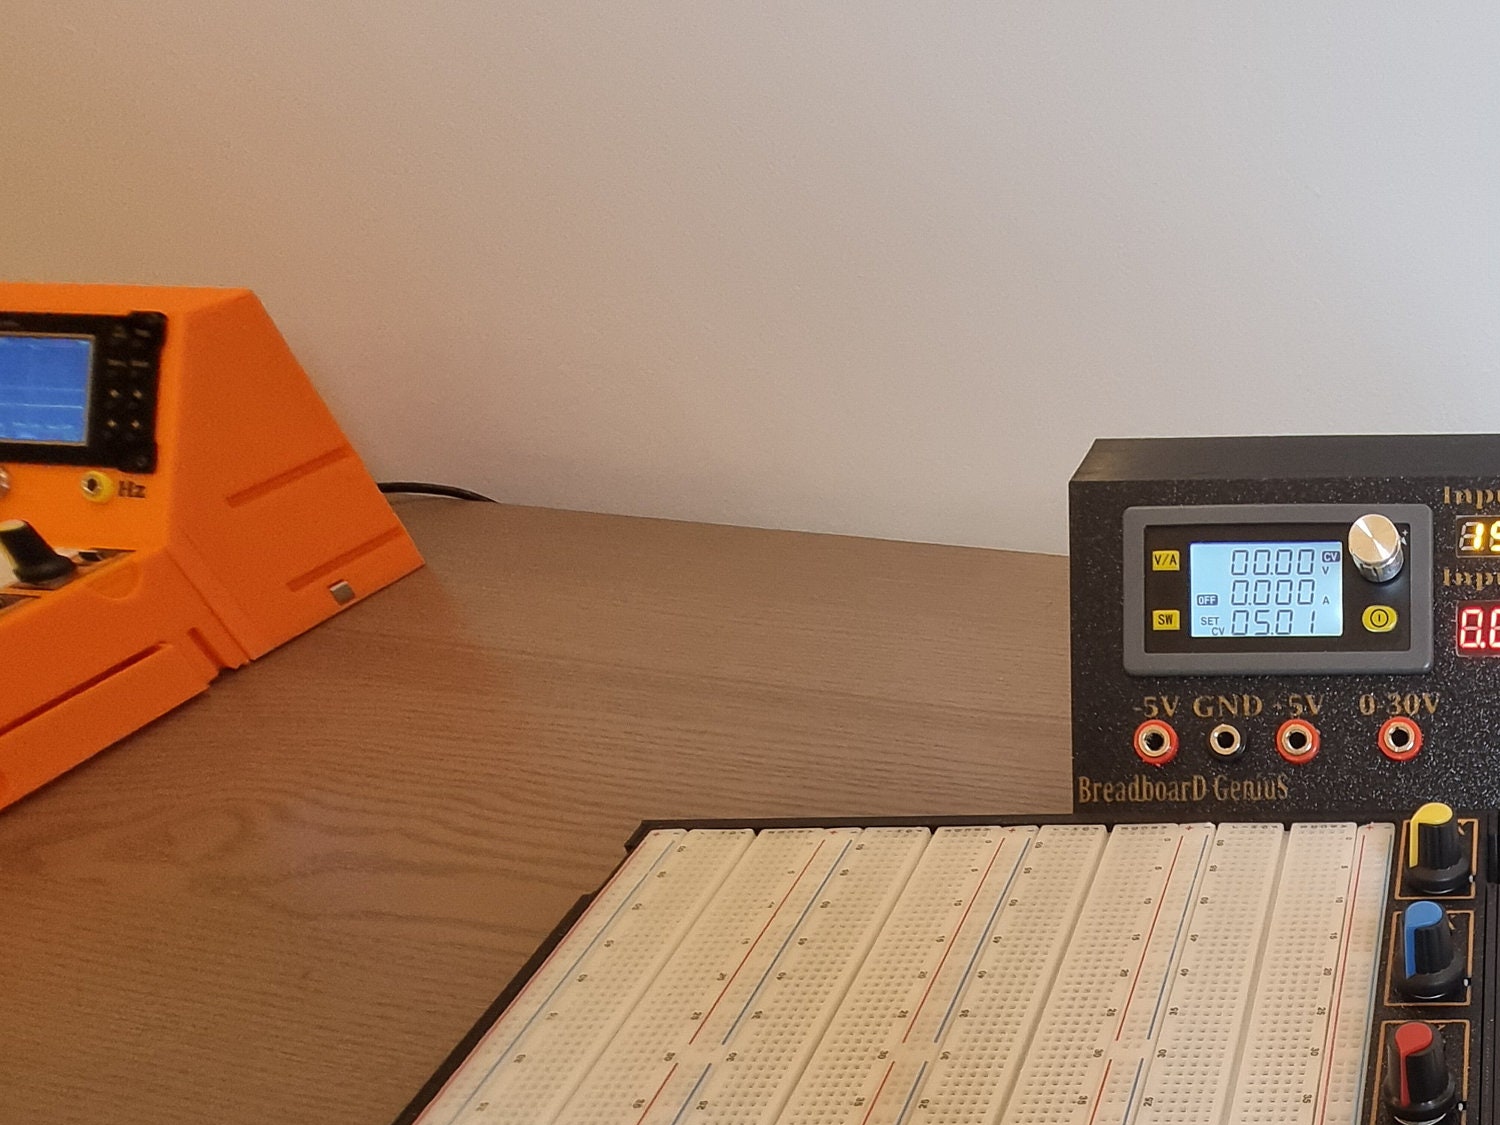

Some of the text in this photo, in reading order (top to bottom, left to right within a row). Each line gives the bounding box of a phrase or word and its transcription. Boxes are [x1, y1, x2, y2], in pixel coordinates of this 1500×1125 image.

[118, 480, 146, 498] Hz
[1154, 554, 1178, 567] V/A
[1231, 549, 1315, 576] 00.00
[1323, 552, 1340, 562] CV
[1322, 566, 1329, 575] V
[1231, 579, 1315, 606] 0.000
[1198, 595, 1217, 605] OFF
[1322, 596, 1330, 605] A
[1157, 614, 1173, 625] SW
[1200, 617, 1219, 626] SET
[1231, 609, 1316, 636] 05.01
[1211, 627, 1225, 636] CV
[1193, 695, 1264, 718] GND
[1358, 692, 1442, 717] 0-30V
[1078, 774, 1291, 804] BreadboarD GeniuS
